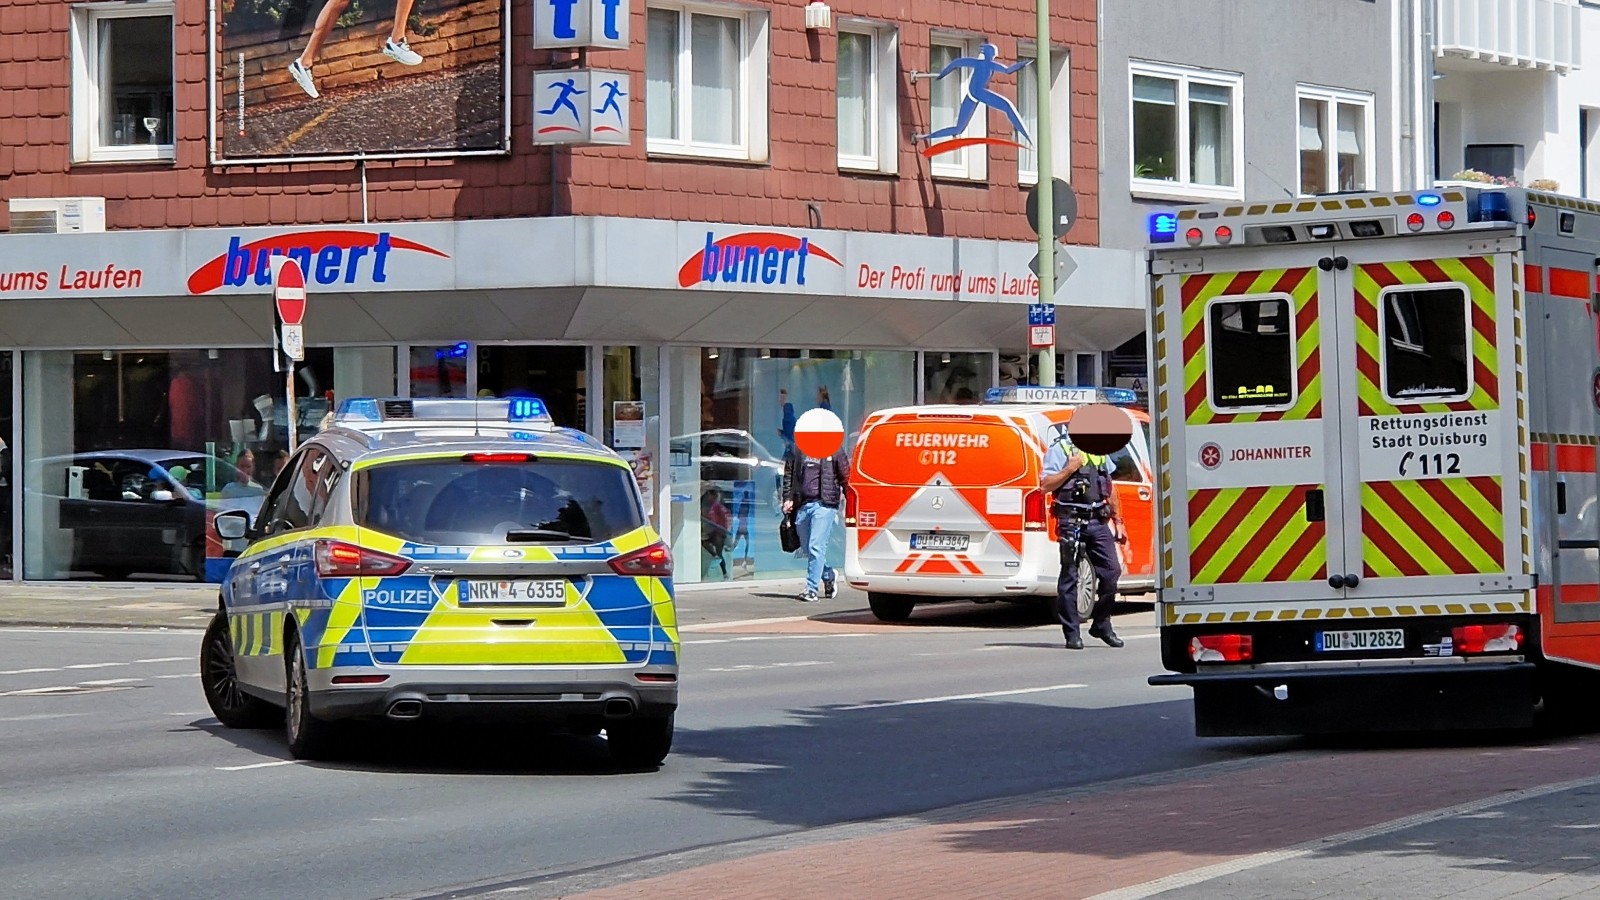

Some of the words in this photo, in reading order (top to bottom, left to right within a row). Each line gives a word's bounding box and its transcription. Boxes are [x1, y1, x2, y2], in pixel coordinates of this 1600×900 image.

[222, 232, 391, 287] bunert
[701, 231, 808, 286] bunert
[0, 271, 48, 291] ums
[59, 263, 142, 290] Laufen
[858, 264, 884, 289] Der
[890, 266, 925, 291] Profi
[931, 269, 962, 293] rund
[967, 276, 996, 295] ums
[1002, 272, 1040, 296] Laufe
[1025, 389, 1087, 400] NOTARZT
[1370, 412, 1487, 431] Rettungsdienst
[895, 432, 990, 448] FEUERWEHR
[1372, 434, 1412, 449] Stadt
[1418, 432, 1487, 447] Duisburg
[932, 450, 957, 465] 112
[1229, 445, 1311, 461] JOHANNITER
[1419, 453, 1461, 475] 112
[917, 535, 928, 546] DU
[933, 535, 944, 546] FW
[946, 536, 967, 547] 3847
[365, 589, 433, 605] POLIZEI
[469, 581, 499, 599] NRW
[508, 581, 564, 599] 4-6355
[1324, 633, 1341, 649] DU
[1350, 632, 1367, 648] JU
[1369, 631, 1402, 648] 2832
